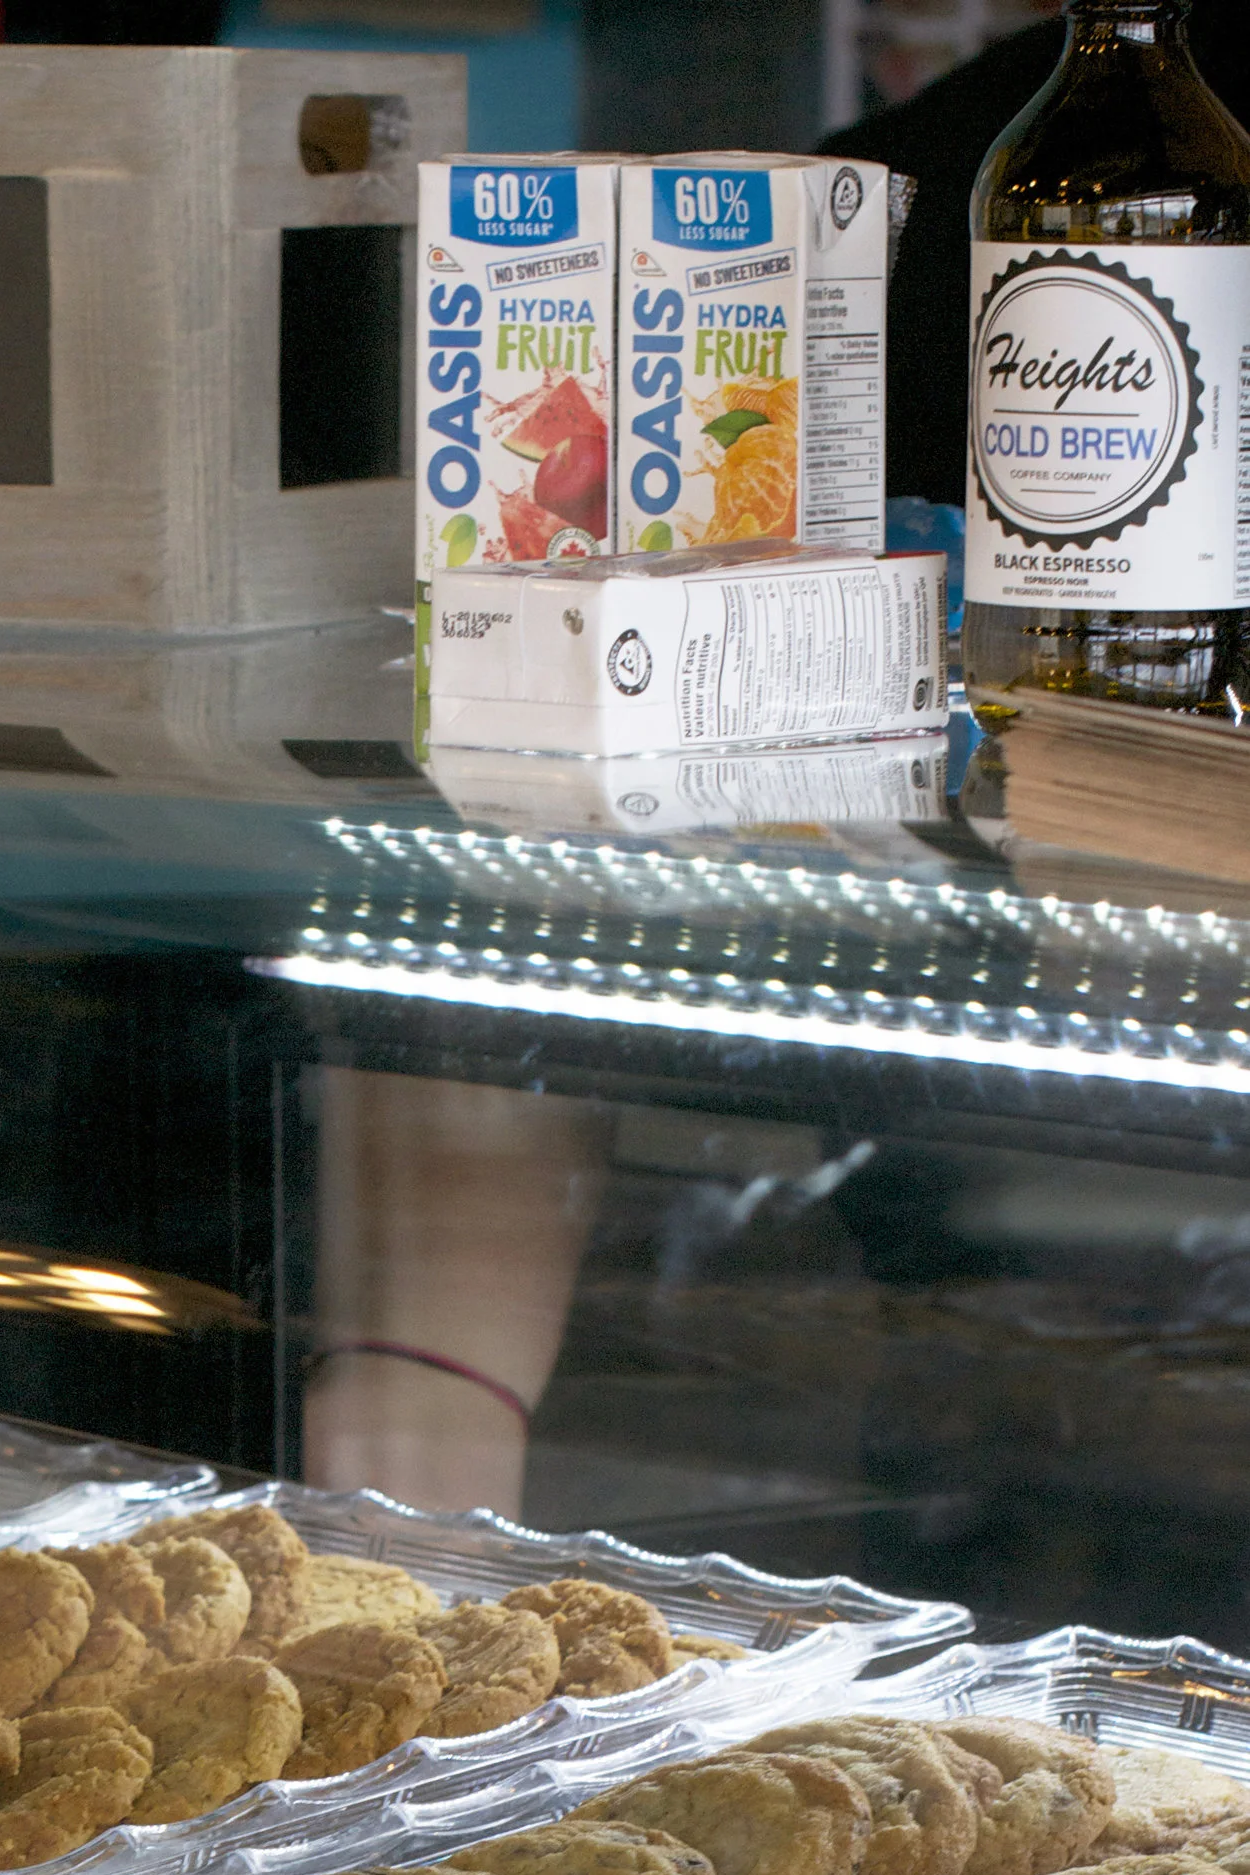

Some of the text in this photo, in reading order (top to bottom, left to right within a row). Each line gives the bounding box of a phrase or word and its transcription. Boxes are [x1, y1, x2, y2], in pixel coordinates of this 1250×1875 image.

[474, 172, 553, 221] 60%
[675, 176, 749, 224] 60%
[478, 222, 506, 236] LESS
[679, 226, 705, 240] LESS
[495, 250, 599, 284] NO SWEETENERS
[693, 255, 791, 288] NO SWEETENERS
[499, 298, 595, 322] HYDRA
[698, 304, 786, 328] HYDRA
[986, 332, 1156, 410] Heights
[426, 282, 483, 509] OASIS
[630, 287, 684, 515] OASIS
[985, 423, 1157, 461] COLD BREW
[1010, 469, 1112, 483] COFFEE COMPANY
[994, 554, 1131, 573] BLACK ESPRESSO
[1024, 576, 1064, 586] ESPRESSO
[682, 639, 698, 737] Nutrition Facts
[694, 633, 712, 738] Valeur nutritive
